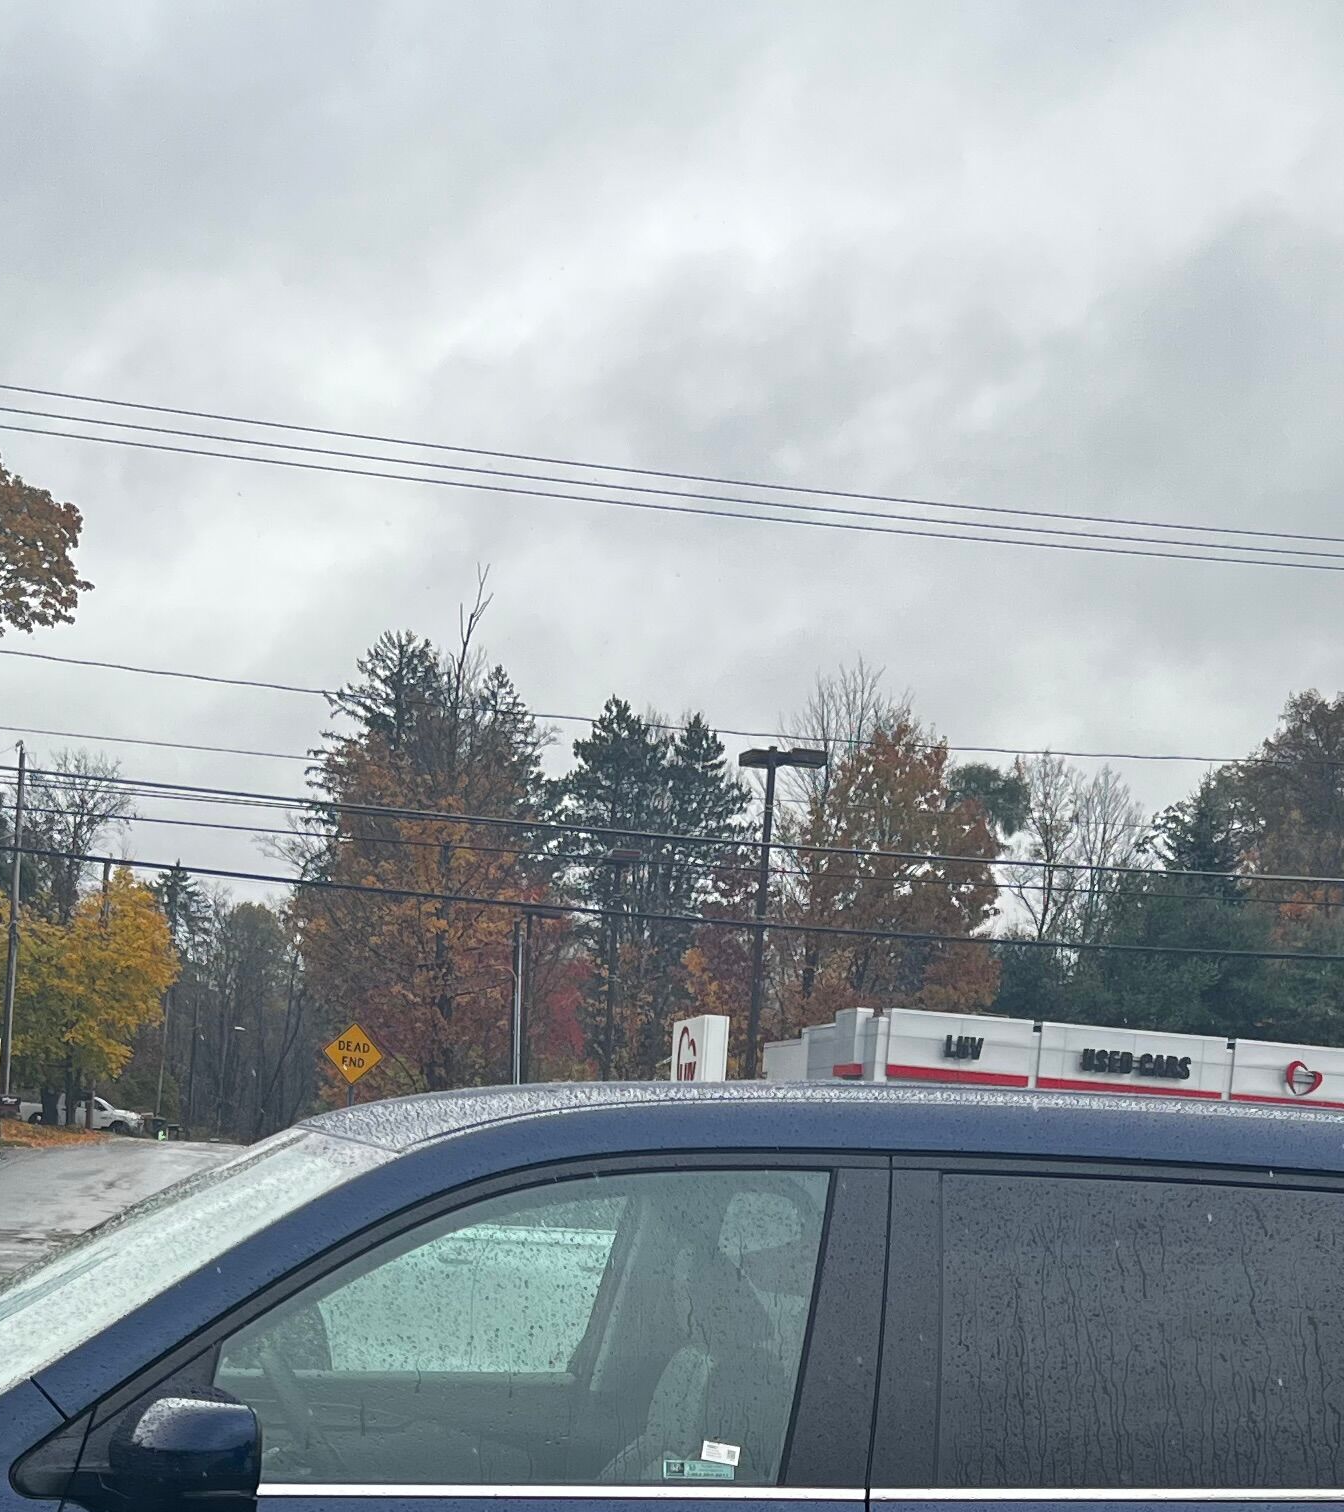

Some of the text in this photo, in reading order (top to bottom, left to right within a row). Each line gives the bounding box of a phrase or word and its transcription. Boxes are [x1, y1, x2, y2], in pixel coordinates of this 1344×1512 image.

[338, 1040, 370, 1053] DEAD
[944, 1034, 985, 1060] LUV
[341, 1055, 365, 1068] END
[1081, 1048, 1192, 1079] USED CARS
